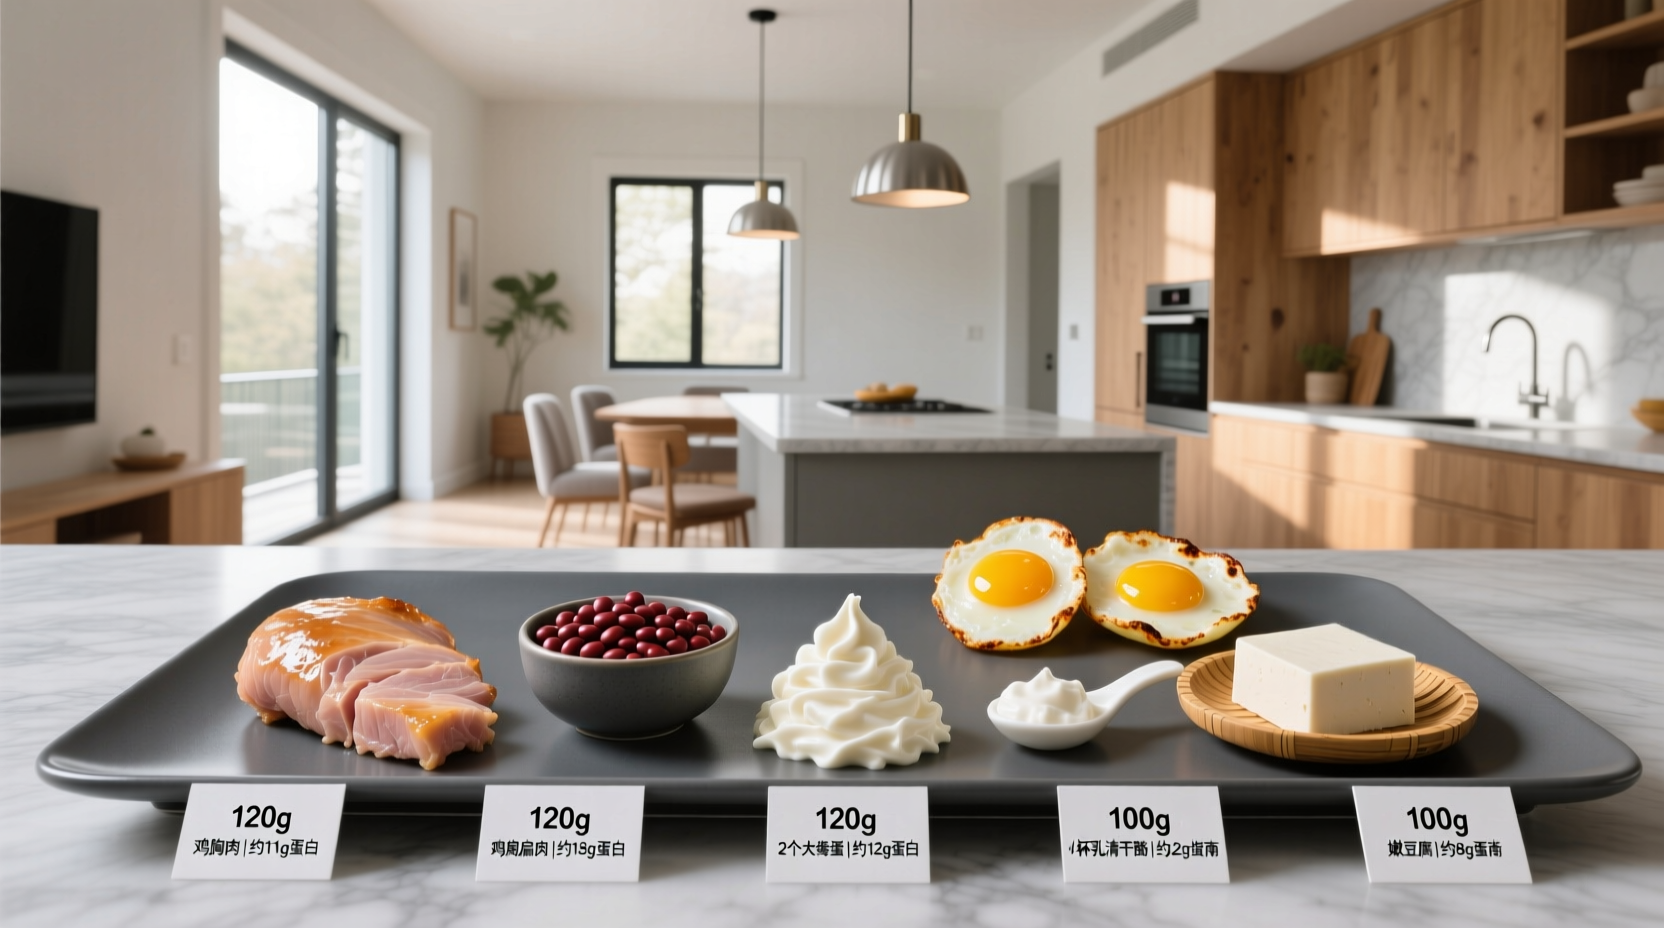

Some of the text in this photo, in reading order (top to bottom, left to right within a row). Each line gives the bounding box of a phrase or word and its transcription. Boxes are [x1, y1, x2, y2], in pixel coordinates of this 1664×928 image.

[233, 805, 292, 834] 120g
[530, 806, 590, 836] 120g
[816, 807, 876, 836] 120g
[1109, 806, 1171, 836] 100g
[1406, 806, 1468, 837] 100g
